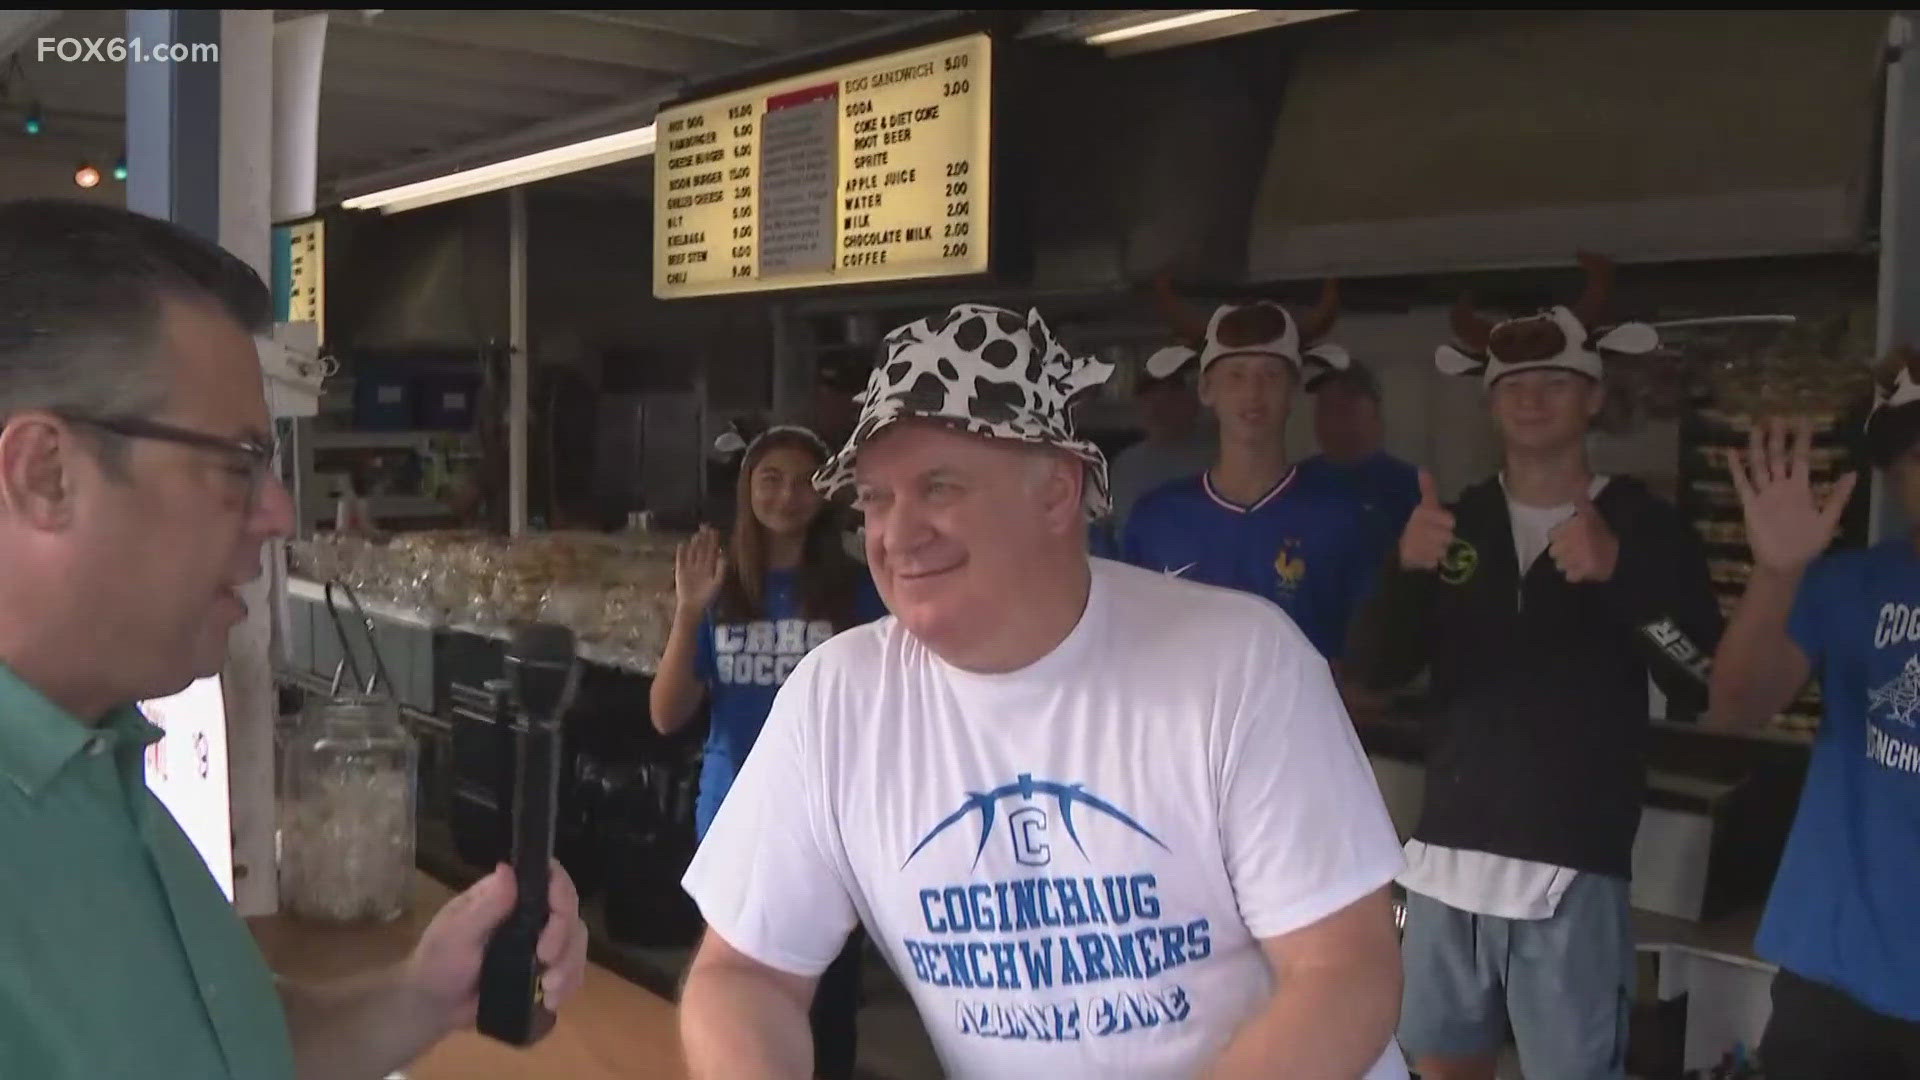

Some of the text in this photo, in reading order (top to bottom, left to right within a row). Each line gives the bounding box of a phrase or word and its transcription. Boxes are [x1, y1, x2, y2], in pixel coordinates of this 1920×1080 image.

[871, 62, 934, 88] SANDWICH
[846, 78, 969, 118] SODA 3.00
[854, 117, 878, 134] COKE
[889, 110, 912, 128] DIET
[915, 105, 940, 122] COKE
[854, 127, 911, 151] ROOT BEER
[854, 151, 888, 169] SPRITE
[845, 159, 969, 193] APPLE JUICE 2.00
[844, 200, 969, 231] MILK 2.00
[845, 192, 882, 211] WATER
[843, 221, 969, 249] CHOCOLATE MILK 2.00
[843, 242, 968, 267] COFFEE 2.00
[1009, 806, 1050, 867] C
[919, 873, 1161, 934] COGINCHAUG
[904, 918, 1212, 991] BENCHWARMERS
